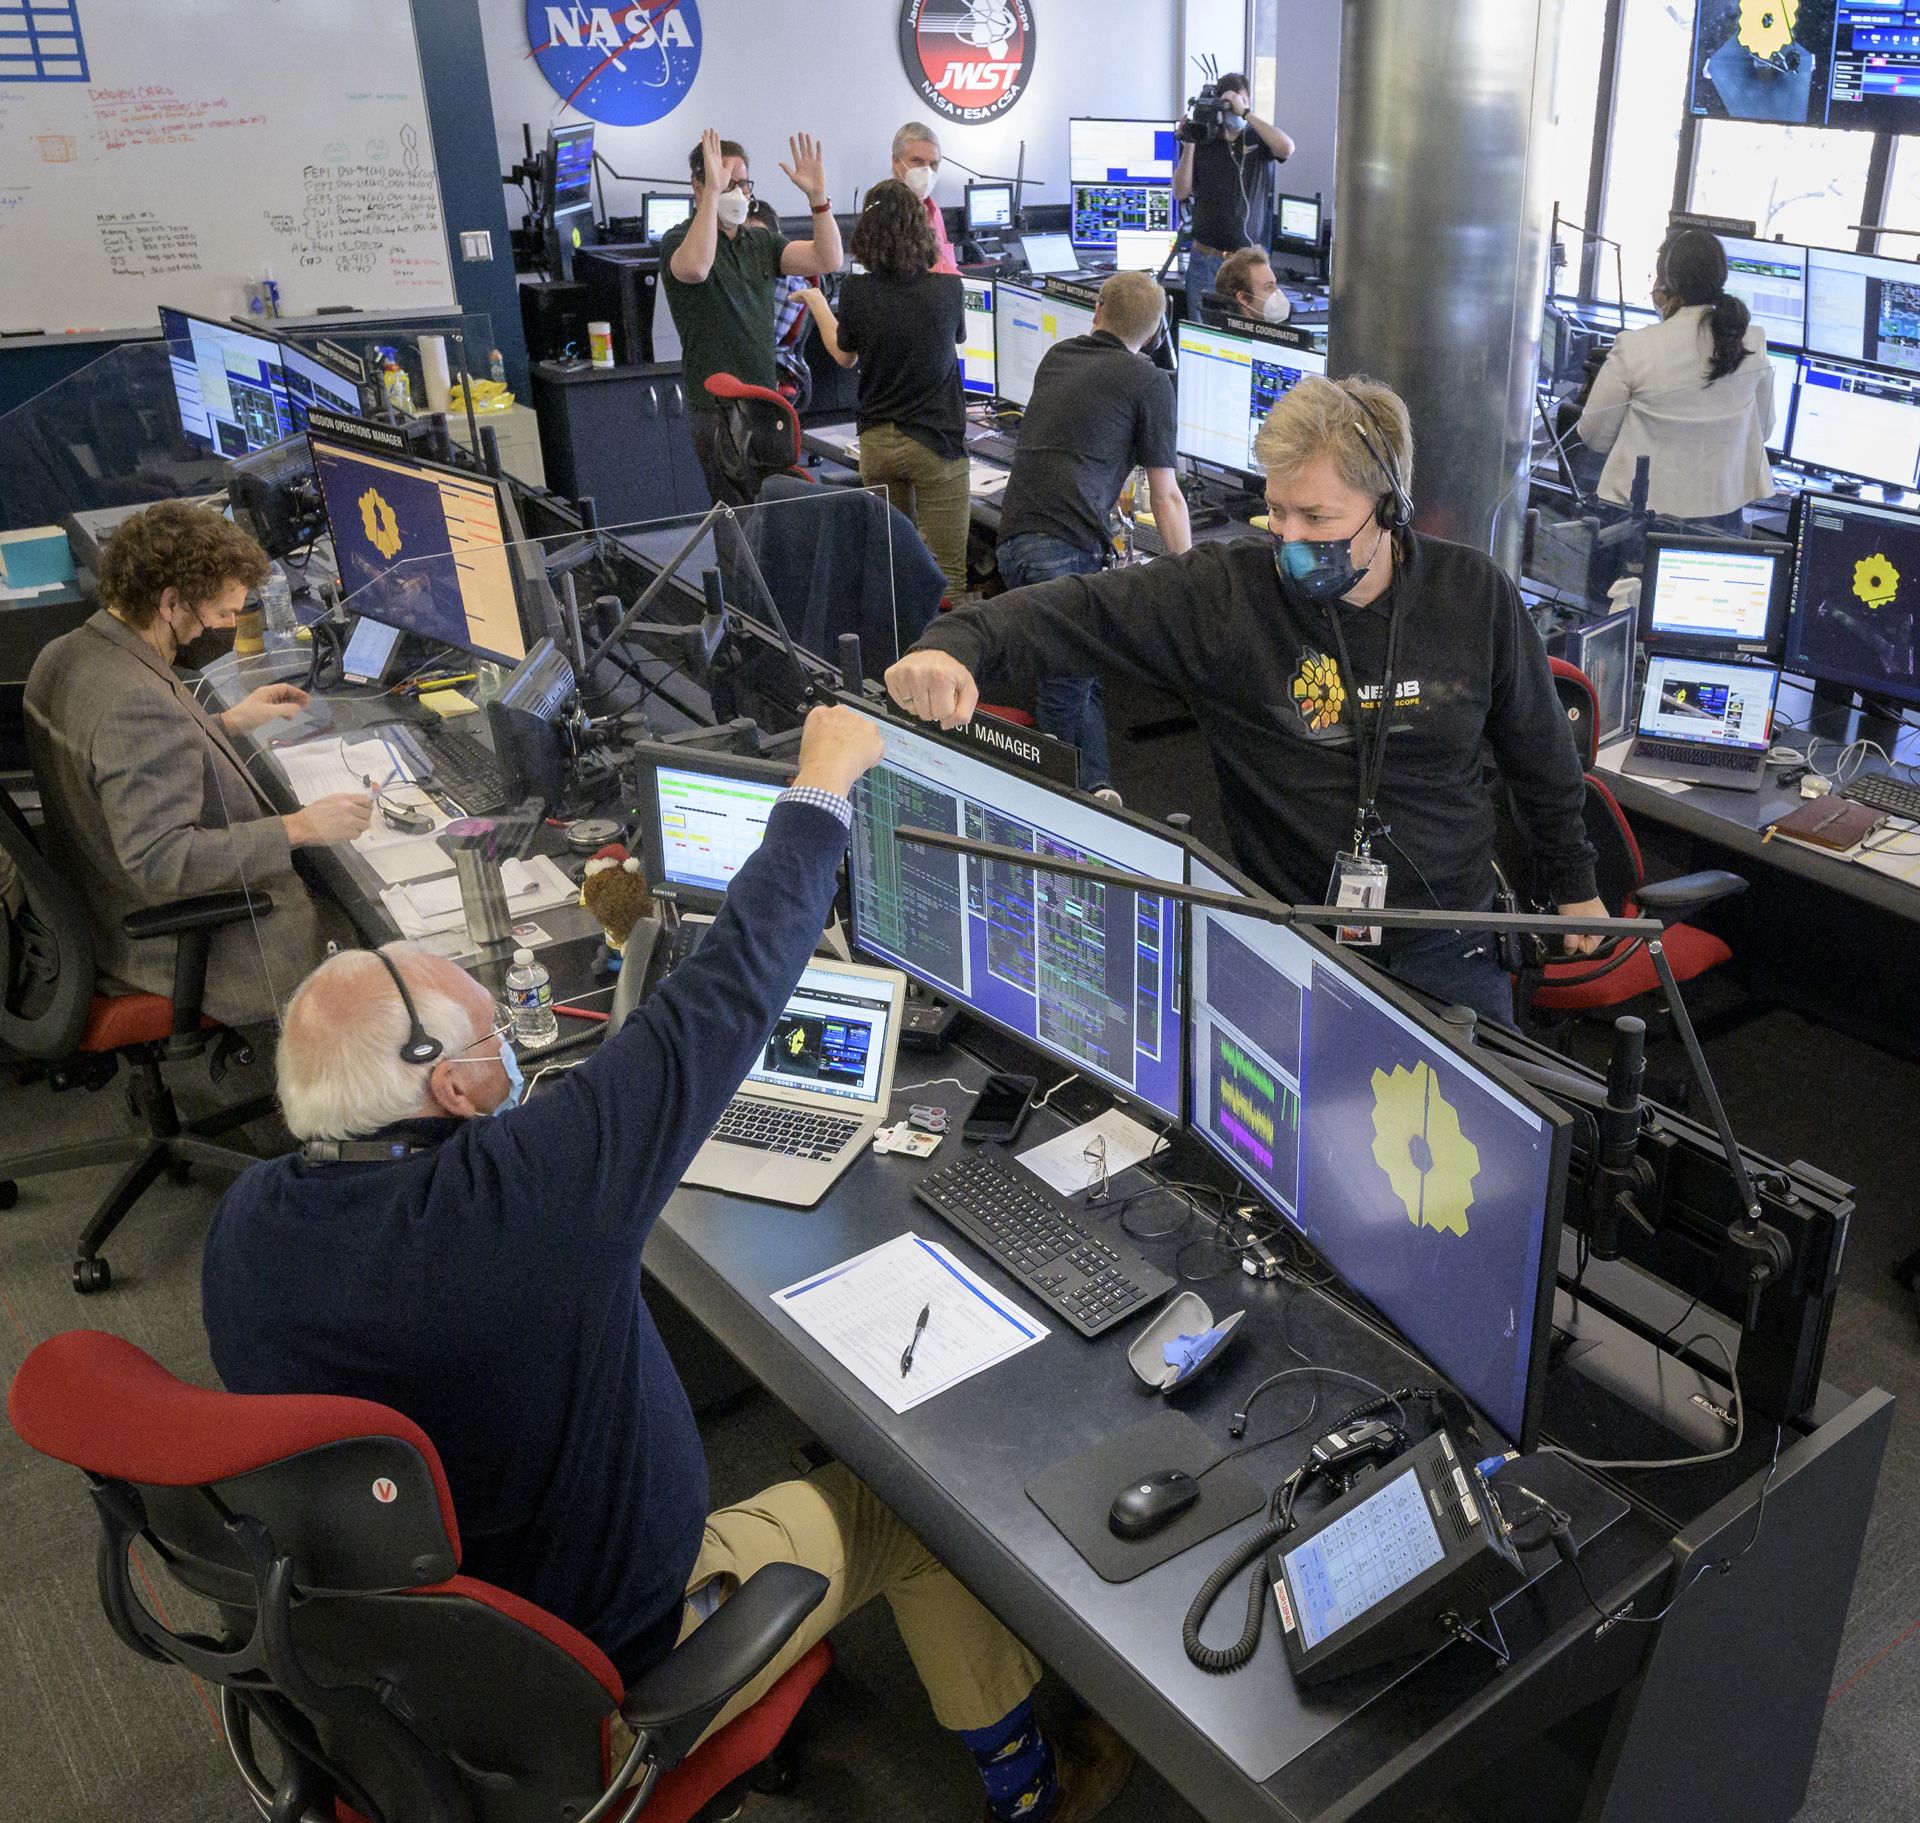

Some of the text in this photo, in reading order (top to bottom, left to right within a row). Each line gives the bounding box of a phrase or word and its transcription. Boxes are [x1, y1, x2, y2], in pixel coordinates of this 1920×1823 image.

[544, 7, 694, 50] NASA
[934, 62, 1022, 90] JWST
[921, 80, 1021, 119] NASA ESA CSA
[1227, 318, 1299, 343] TIMELINE COORDINATOR
[308, 412, 403, 448] MISSION OPERATIONS MANAGER
[974, 723, 1041, 764] MANAGER
[377, 1482, 392, 1499] V
